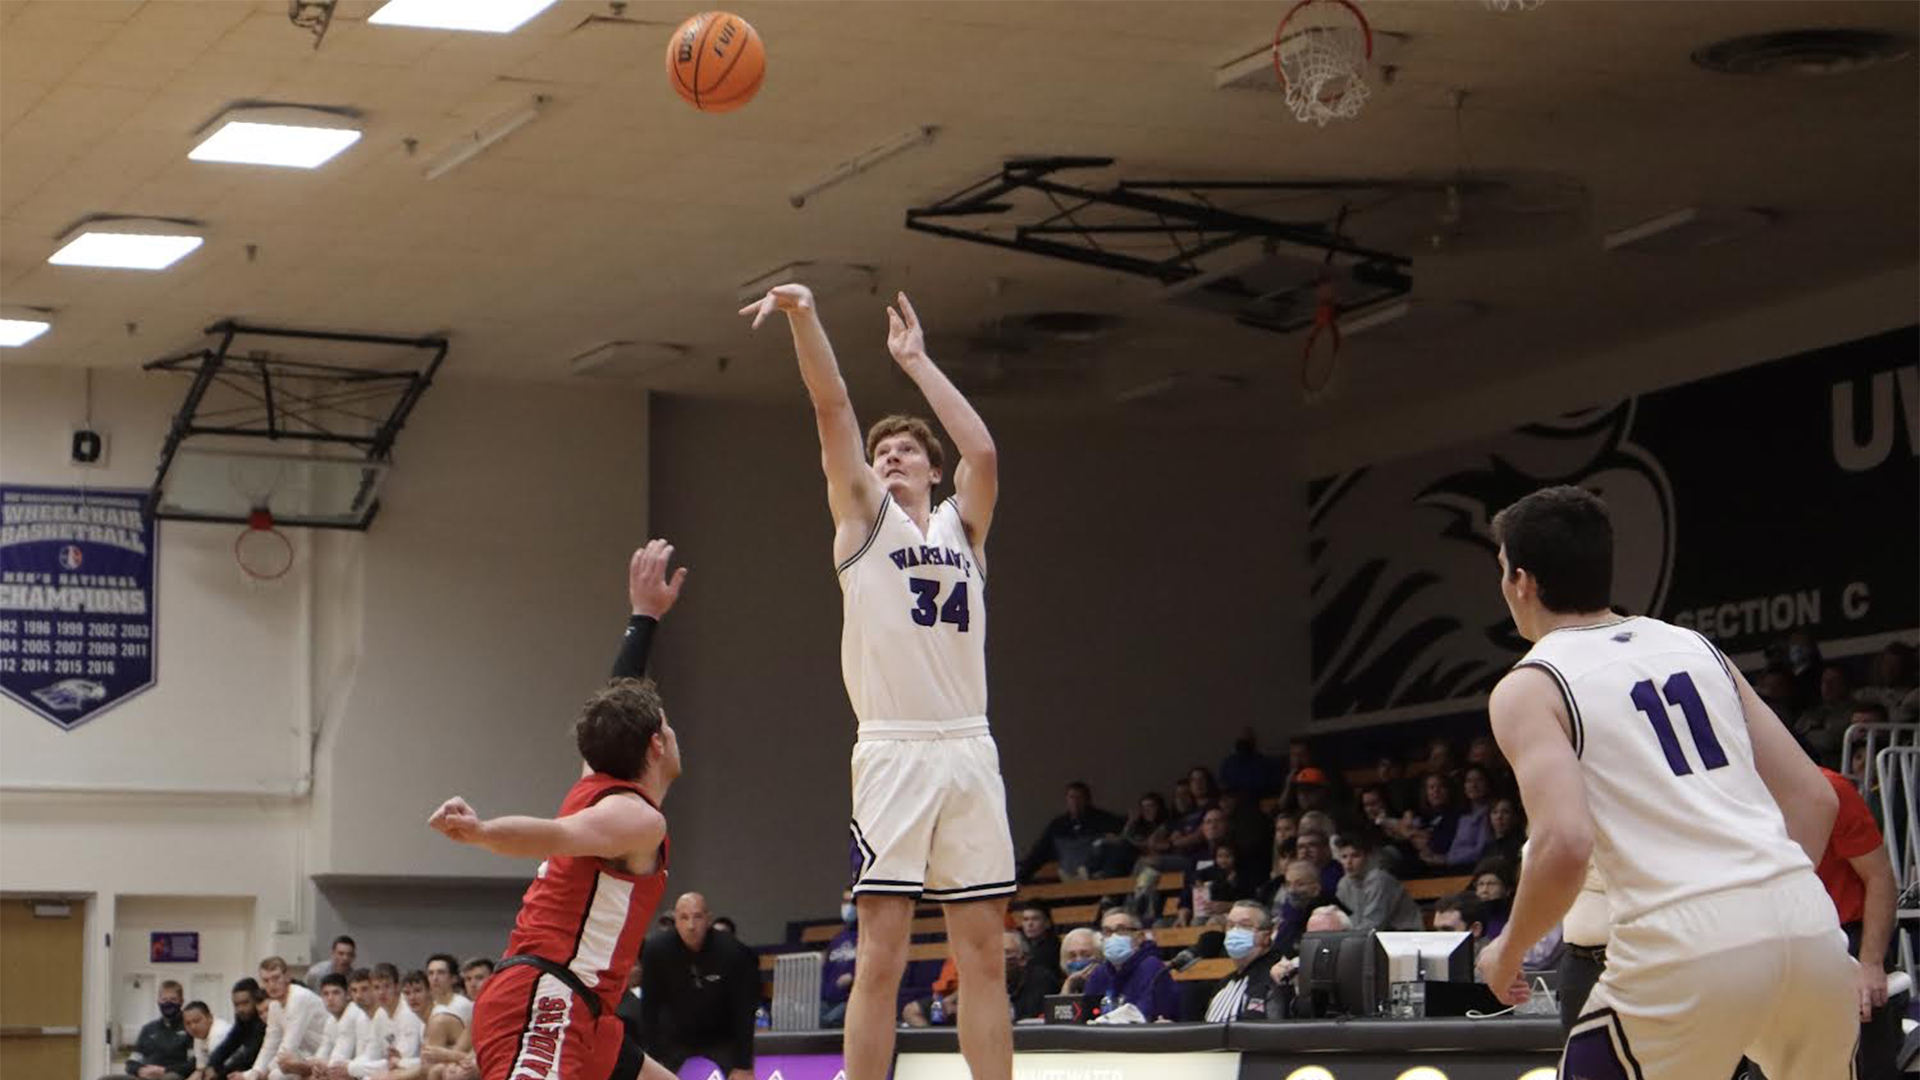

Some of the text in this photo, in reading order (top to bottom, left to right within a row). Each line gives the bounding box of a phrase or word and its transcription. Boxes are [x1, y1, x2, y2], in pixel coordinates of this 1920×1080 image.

[1832, 365, 1920, 472] U
[0, 523, 146, 553] BASKETBALL
[889, 545, 970, 578] WARHAW
[59, 573, 137, 588] NATIONAL
[909, 577, 970, 632] 34
[1842, 582, 1869, 619] C
[55, 641, 83, 655] 2007
[121, 643, 147, 657] 2011
[21, 659, 49, 672] 2014
[55, 660, 82, 673] 2015
[87, 661, 115, 674] 2016
[1630, 671, 1729, 776] 11
